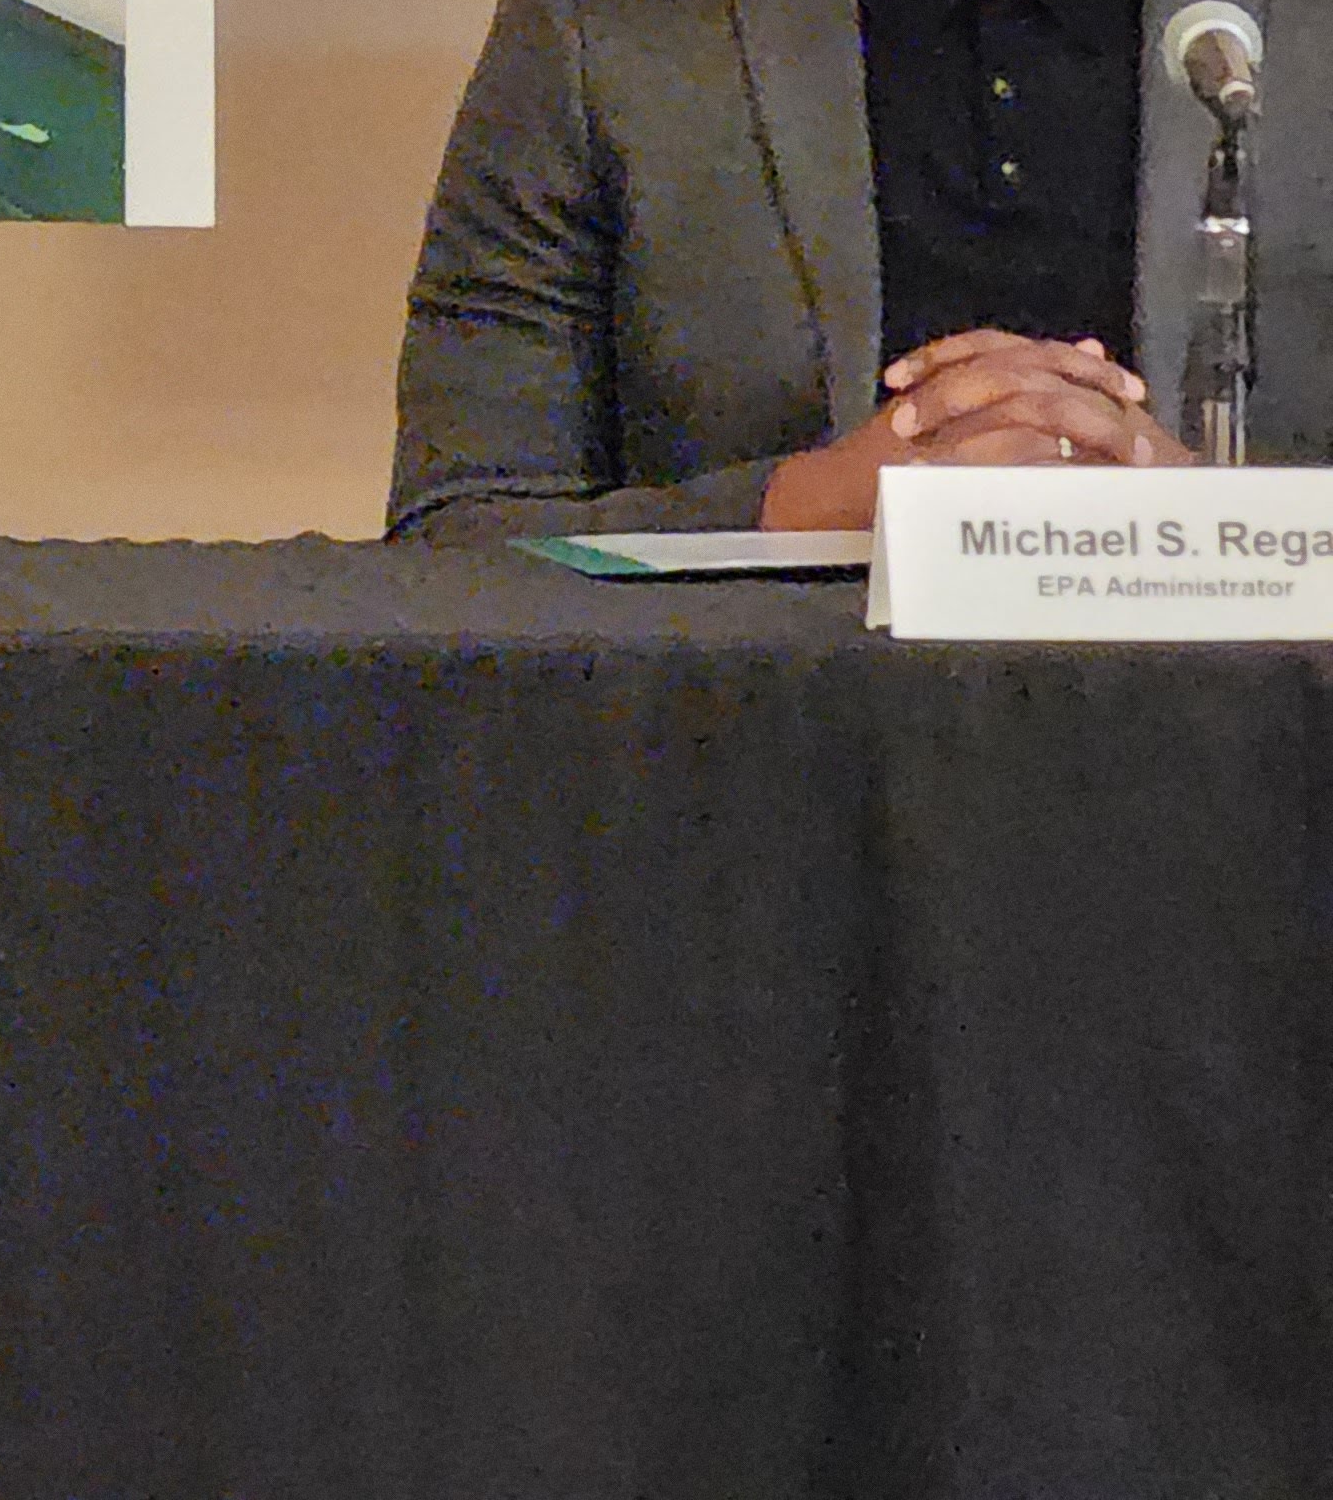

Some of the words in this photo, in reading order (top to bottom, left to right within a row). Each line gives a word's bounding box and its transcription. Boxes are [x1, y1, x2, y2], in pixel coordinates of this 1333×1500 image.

[960, 519, 1139, 558] Michael
[1156, 520, 1200, 558] S.
[1217, 520, 1333, 567] Rega
[1037, 574, 1097, 598] EPA
[1105, 574, 1296, 599] Administrator
